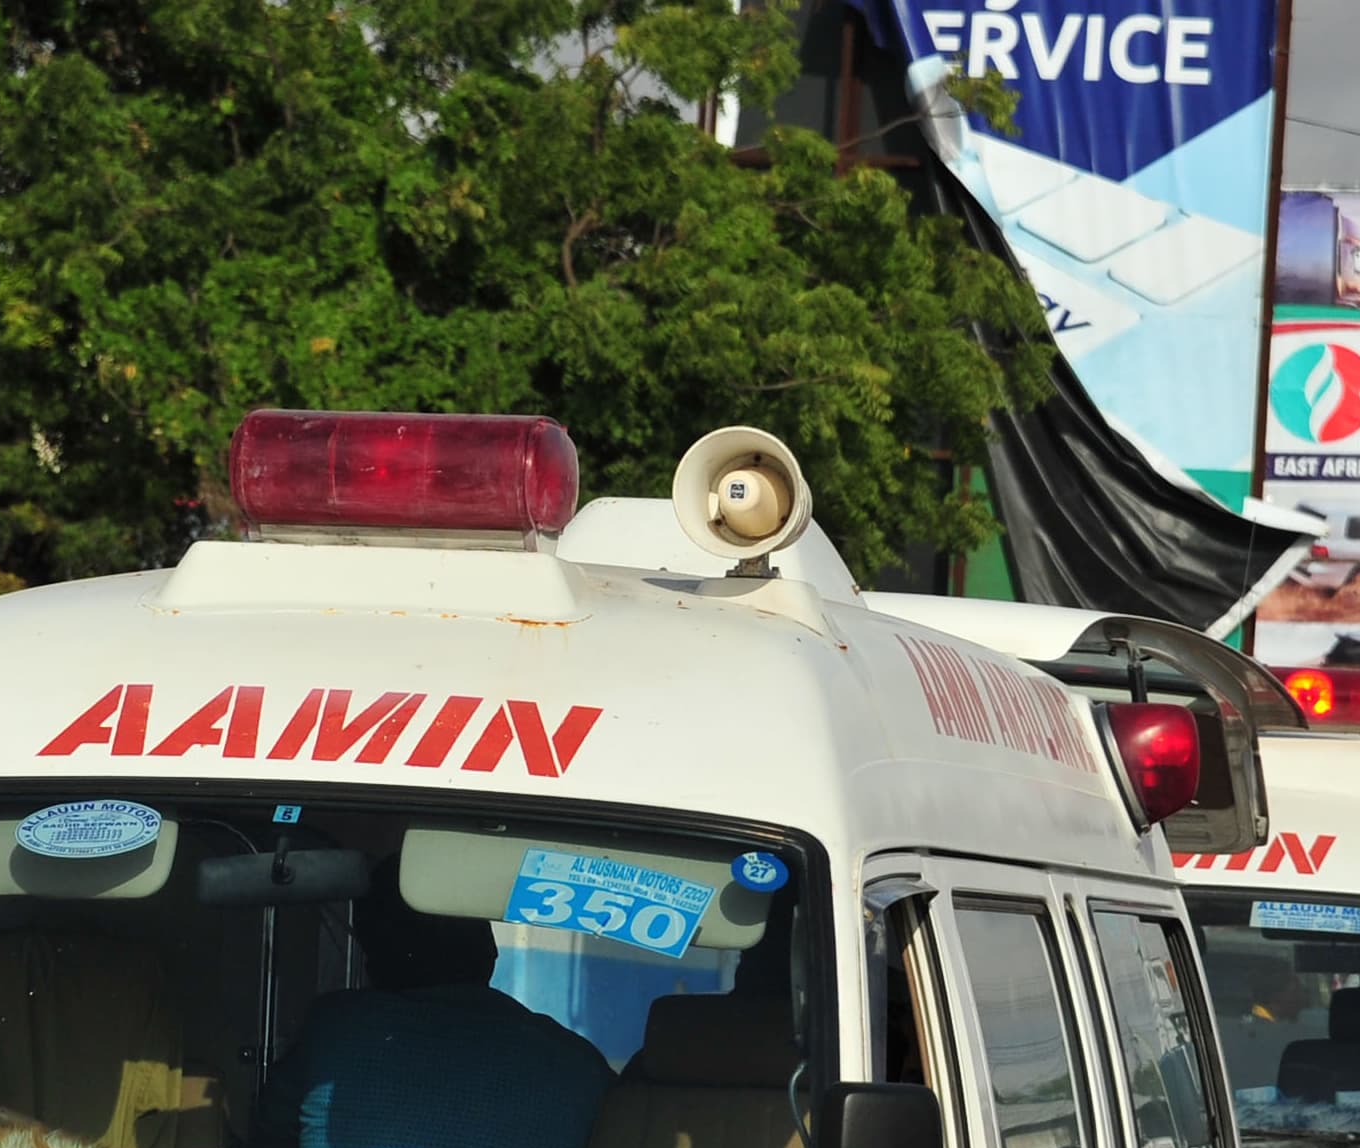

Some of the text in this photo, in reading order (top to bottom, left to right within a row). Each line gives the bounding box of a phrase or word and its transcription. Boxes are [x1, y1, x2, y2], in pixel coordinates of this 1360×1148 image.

[1274, 456, 1318, 476] EAST
[35, 683, 603, 777] AAMIN
[22, 800, 158, 832] ALLAUUN MOTORS
[571, 857, 585, 873] AL
[588, 859, 638, 882] HUSNAIN
[639, 868, 683, 895] MOTORS
[681, 886, 709, 903] FZCO
[750, 866, 769, 880] 27
[519, 882, 687, 950] 350
[1257, 901, 1336, 915] ALLAUUN
